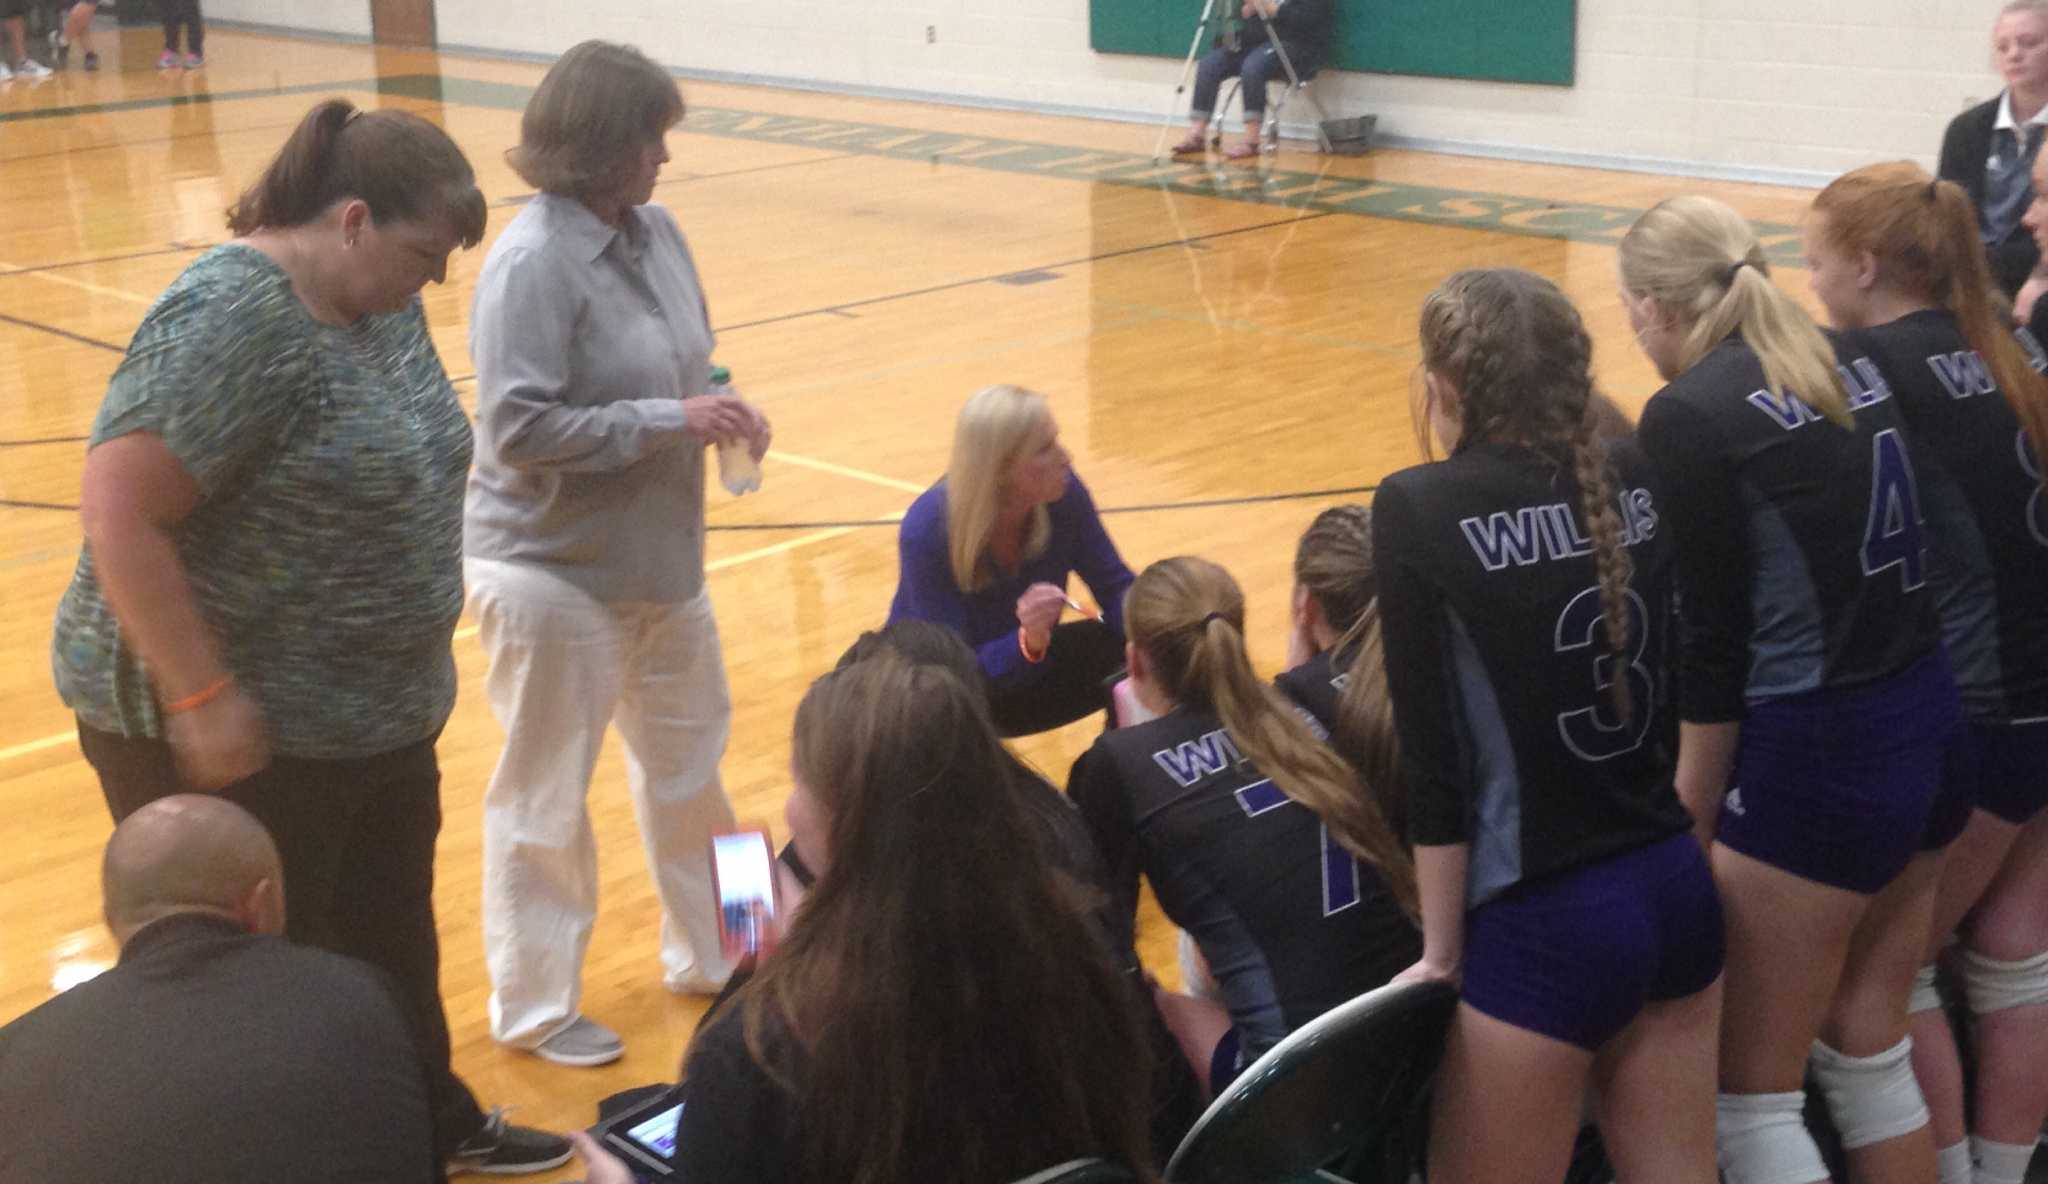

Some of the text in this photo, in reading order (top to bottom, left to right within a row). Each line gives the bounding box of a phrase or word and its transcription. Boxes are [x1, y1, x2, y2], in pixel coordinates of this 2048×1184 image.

[1458, 487, 1660, 571] WILIS
[1859, 427, 1926, 593] 4
[1554, 585, 1654, 761] 3
